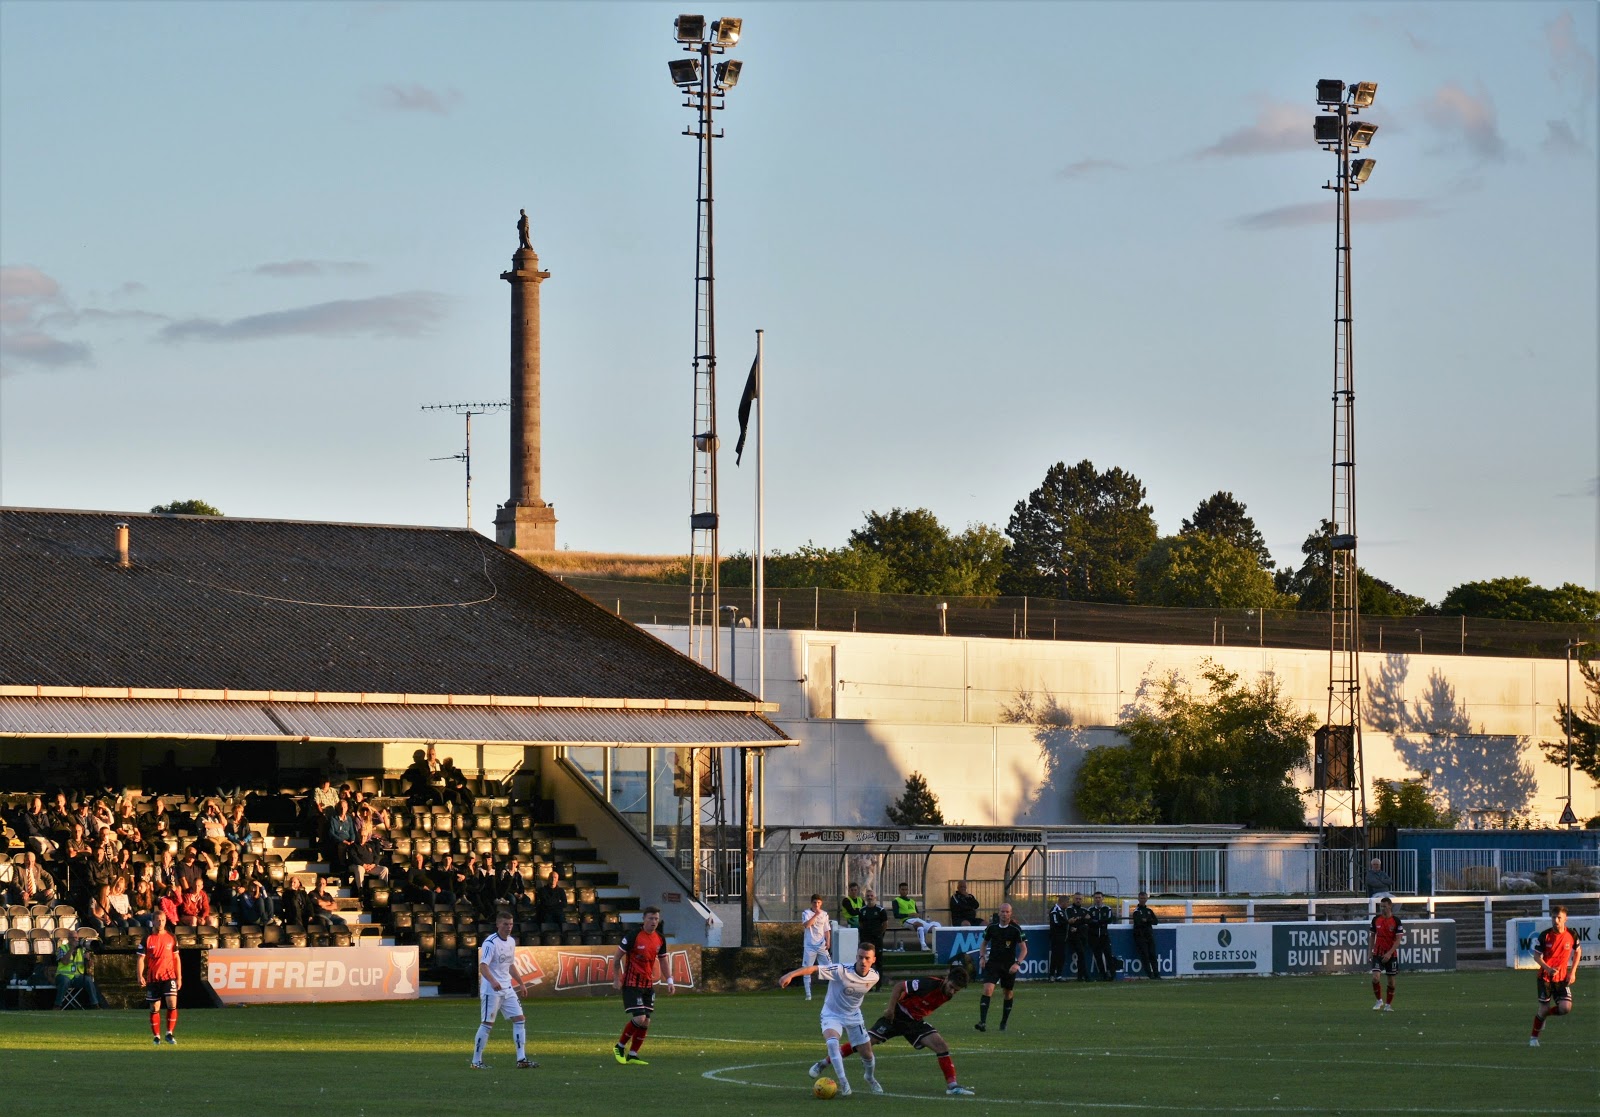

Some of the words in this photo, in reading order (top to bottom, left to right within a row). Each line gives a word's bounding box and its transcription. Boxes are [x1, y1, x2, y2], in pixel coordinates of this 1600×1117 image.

[822, 832, 843, 841] GLASS
[878, 832, 898, 841] GLASS
[943, 832, 977, 842] WINDOWS
[984, 832, 1042, 843] CONSERVATORIES
[1289, 929, 1407, 947] TRANSFORG
[1411, 928, 1440, 945] THE
[1192, 950, 1257, 960] ROBERTSON
[1288, 949, 1330, 966] BUILT
[1333, 947, 1441, 966] ENVIMENT
[208, 960, 347, 990] BETFRED
[348, 967, 383, 986] CUP
